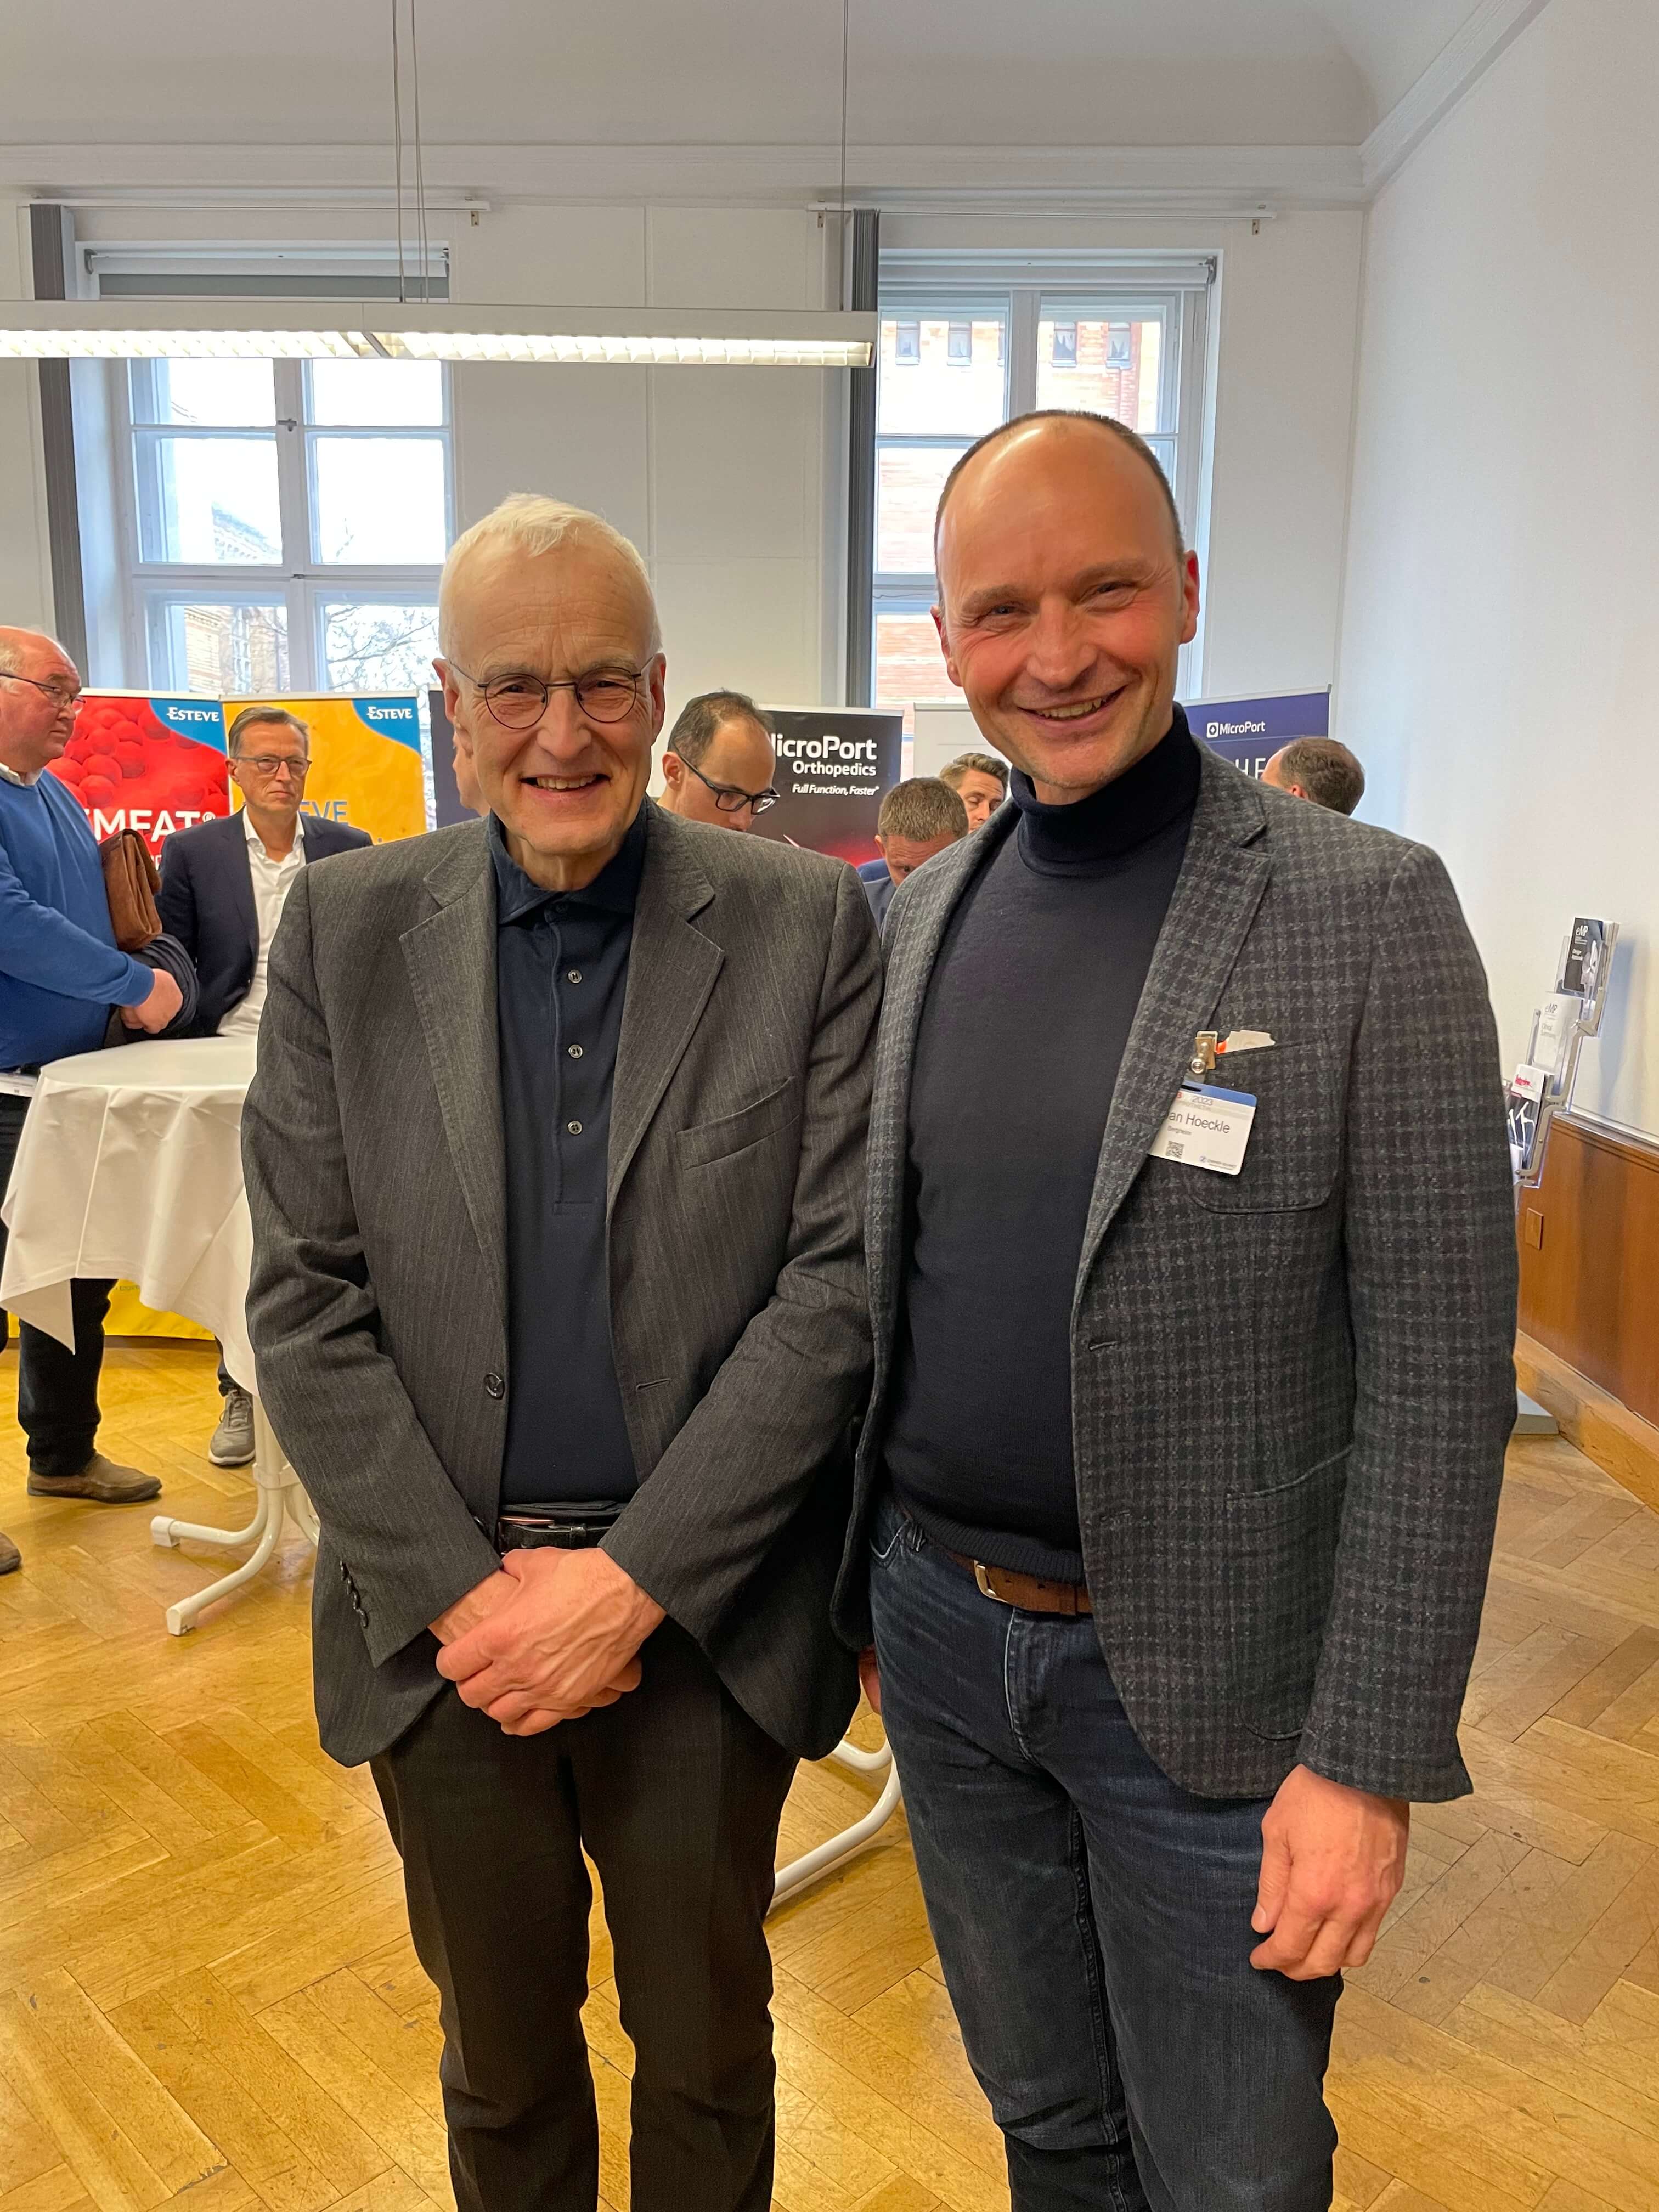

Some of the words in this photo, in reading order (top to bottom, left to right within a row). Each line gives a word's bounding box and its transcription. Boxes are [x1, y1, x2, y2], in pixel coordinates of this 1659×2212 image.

[166, 706, 219, 722] ESTEVE
[366, 706, 413, 720] ESTEVE
[1220, 721, 1266, 735] MicroPort
[792, 760, 877, 778] Orthopedics
[792, 783, 809, 794] Full
[809, 785, 849, 796] Function,
[1192, 1095, 1212, 1106] 2023
[1185, 1113, 1231, 1133] Hoeckle
